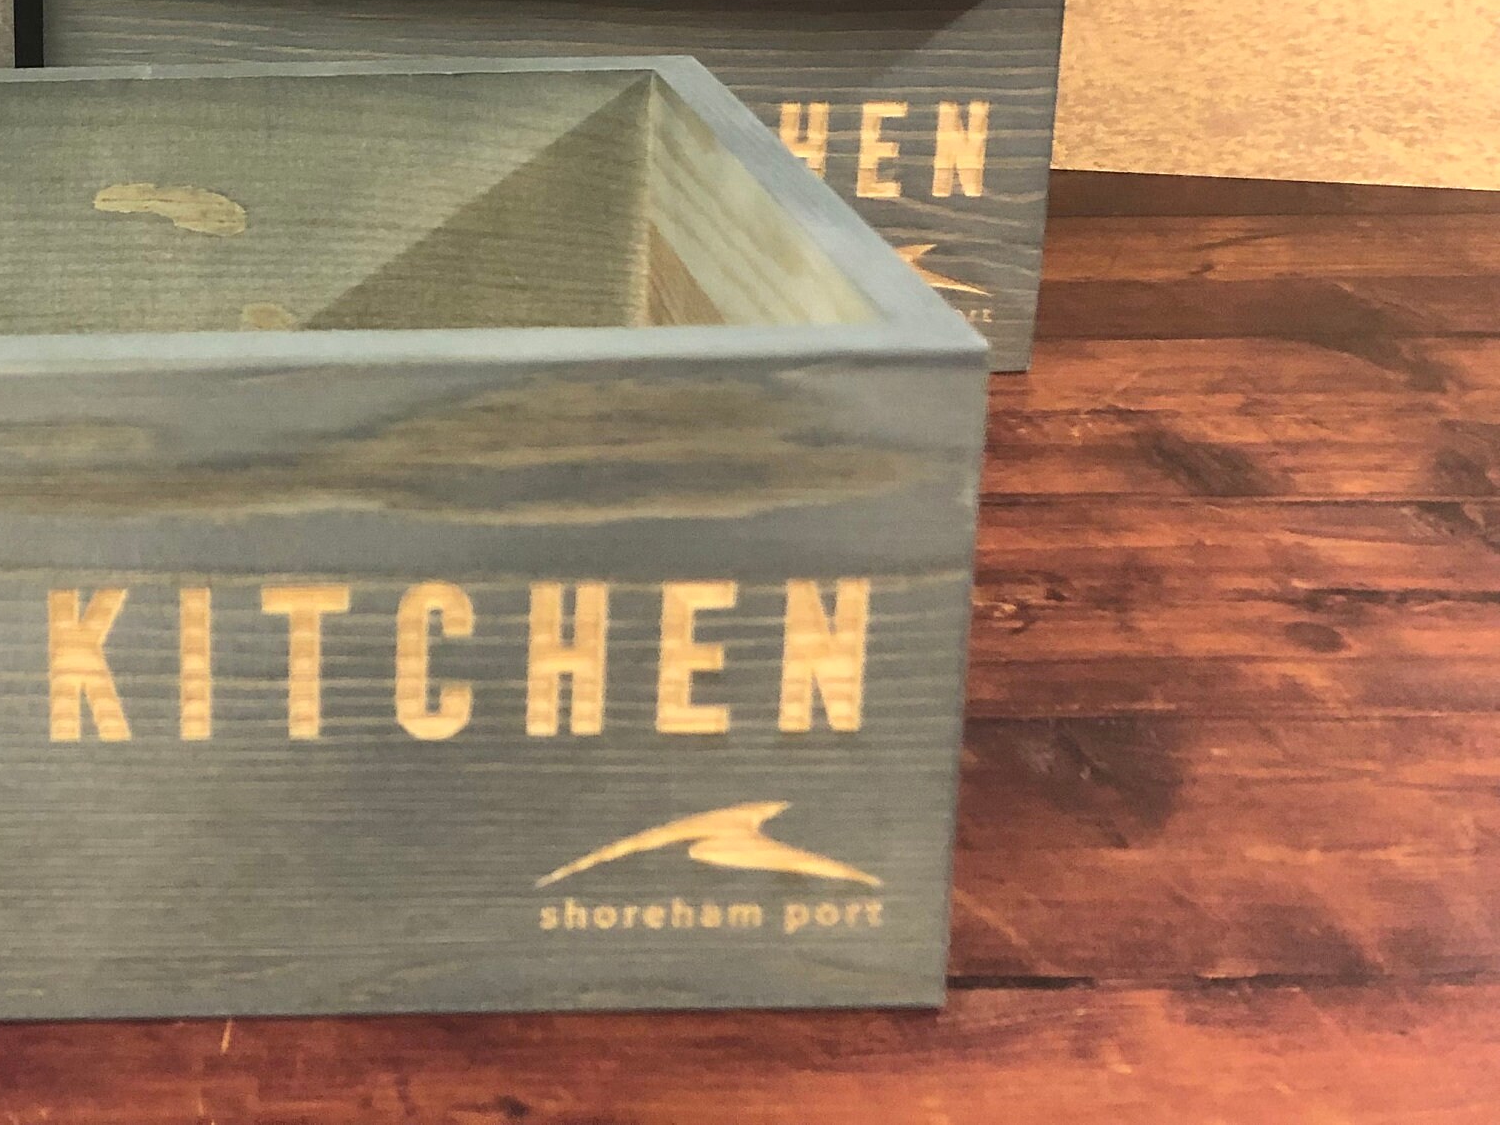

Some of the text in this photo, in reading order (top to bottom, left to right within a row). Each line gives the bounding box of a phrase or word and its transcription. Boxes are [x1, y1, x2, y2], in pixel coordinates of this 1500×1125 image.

[48, 580, 870, 742] KITCHEN
[540, 898, 883, 934] shoreham port
